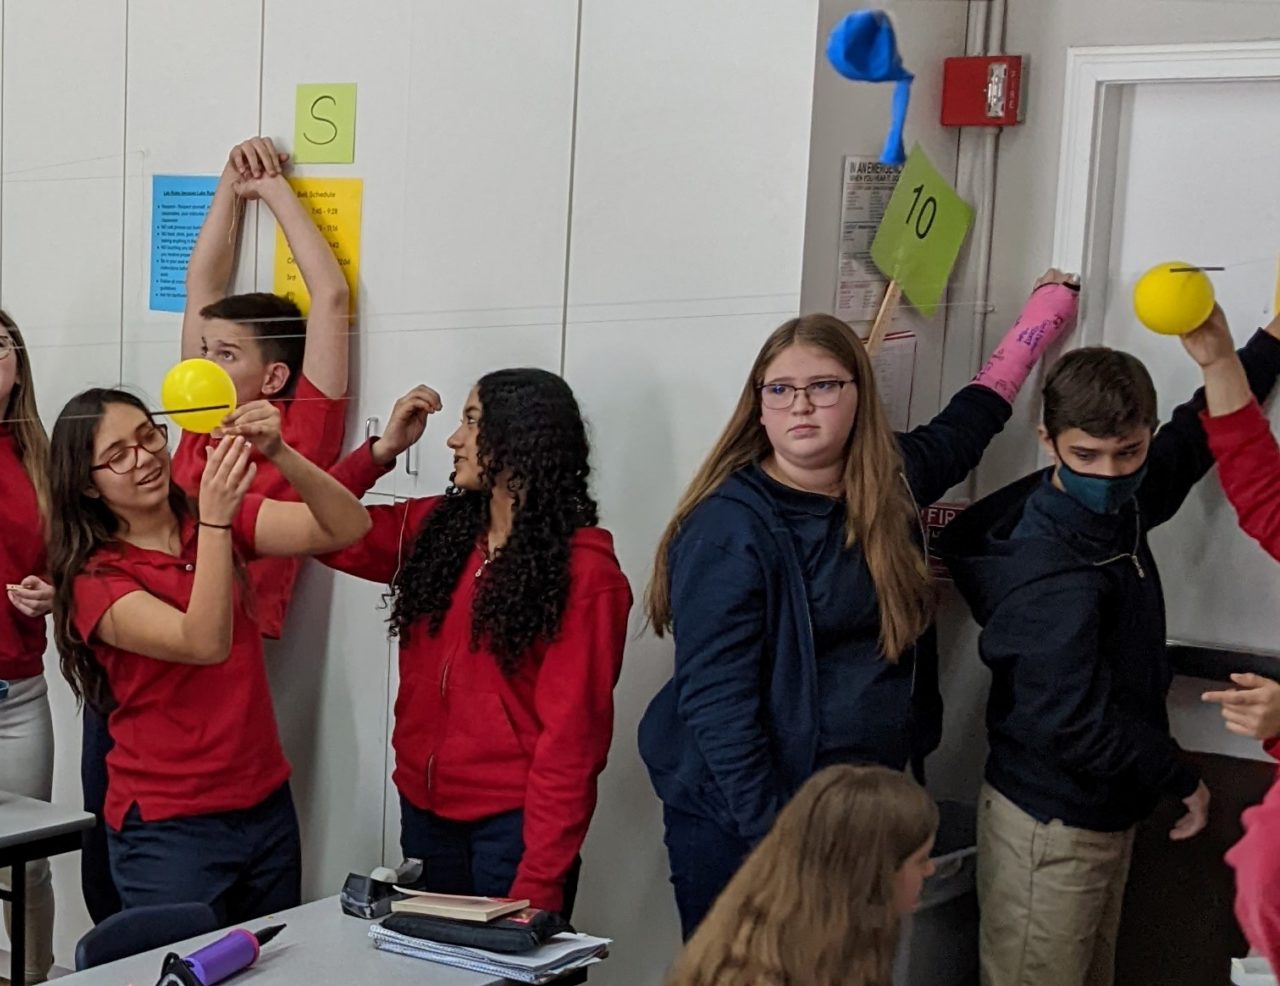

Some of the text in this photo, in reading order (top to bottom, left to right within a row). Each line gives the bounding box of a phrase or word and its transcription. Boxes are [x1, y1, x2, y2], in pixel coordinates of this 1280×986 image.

[303, 95, 338, 145] S
[905, 184, 938, 239] 10
[927, 508, 956, 525] FIR
